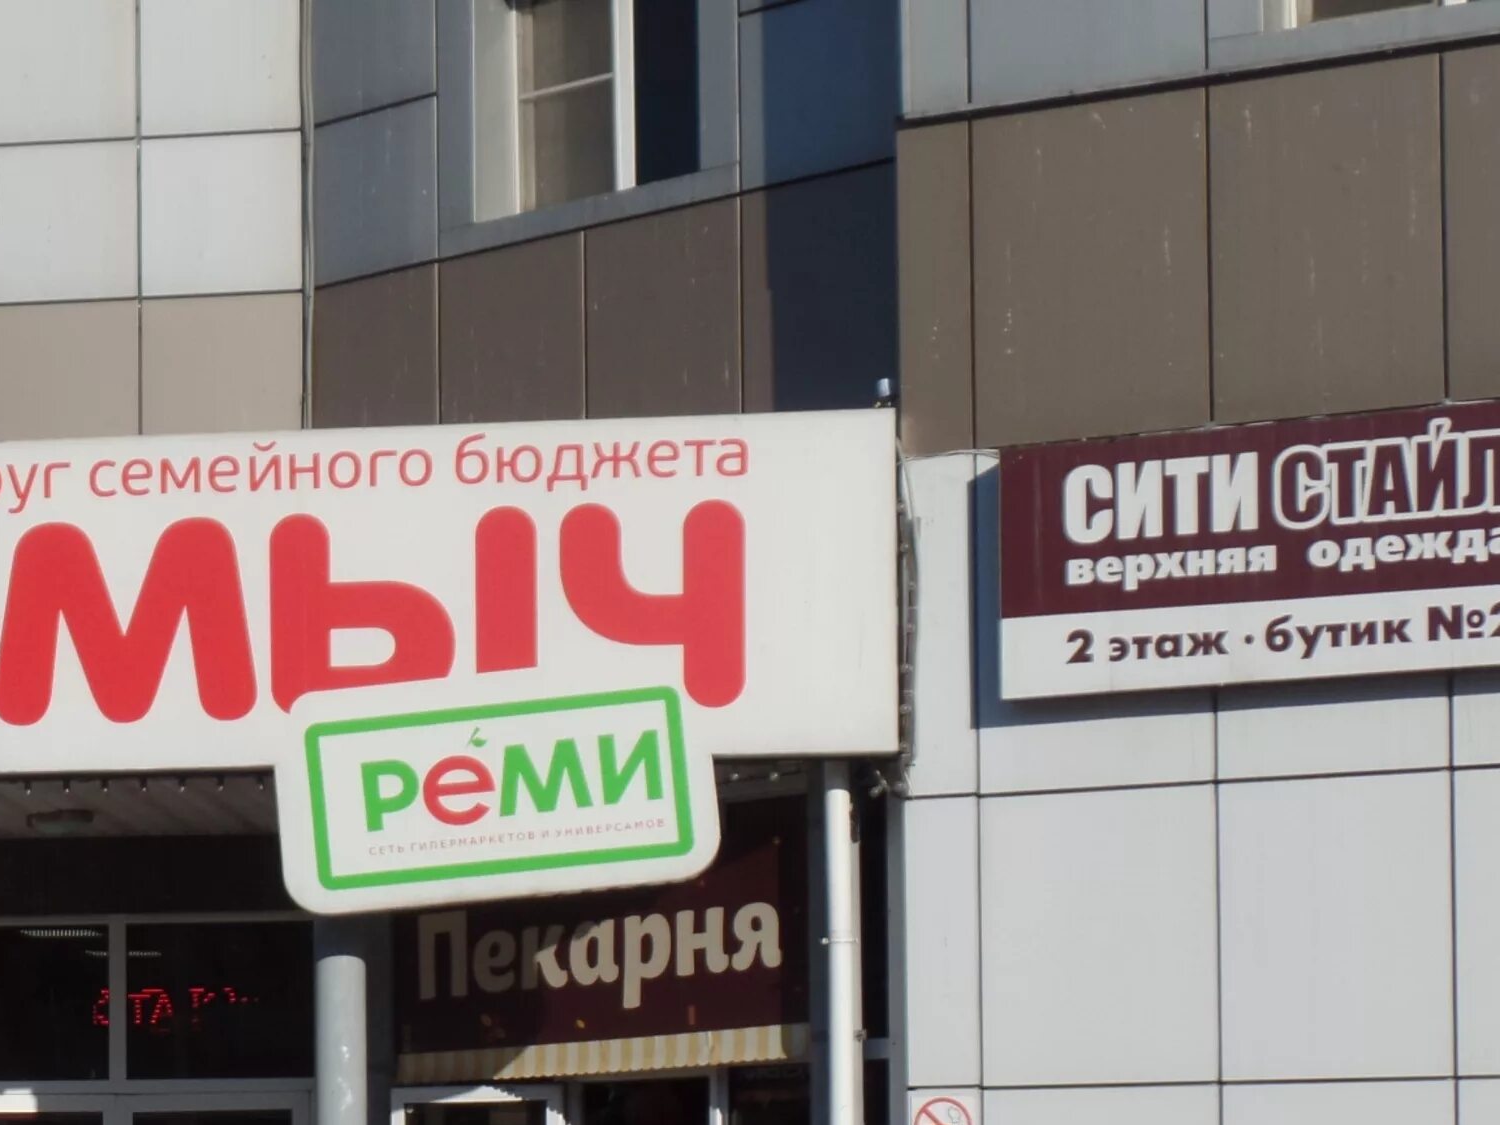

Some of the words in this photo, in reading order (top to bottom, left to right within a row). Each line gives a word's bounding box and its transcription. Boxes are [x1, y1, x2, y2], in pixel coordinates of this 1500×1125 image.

[89, 440, 433, 497] семейного
[454, 432, 749, 491] бюджета
[1064, 451, 1259, 545] СИТИ
[1066, 545, 1278, 591] верхняя
[1066, 629, 1094, 664] 2
[1108, 630, 1229, 663] этаж
[1265, 614, 1412, 660] бутик
[368, 844, 405, 857] СЕТЬ
[409, 830, 536, 852] ГИПЕРМАРКЕТОВ
[541, 829, 550, 839] И
[555, 818, 666, 838] УНИВЕРСАМОВ
[418, 902, 782, 1009] Пекарня
